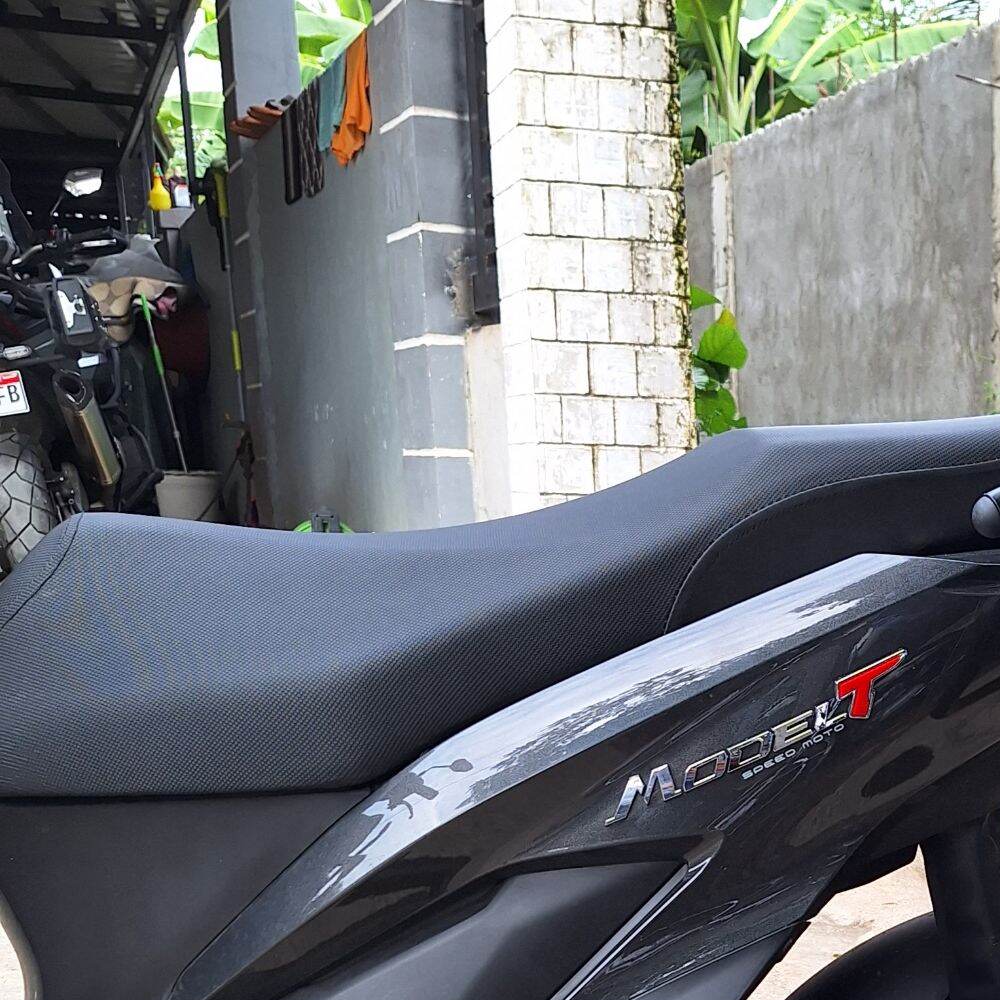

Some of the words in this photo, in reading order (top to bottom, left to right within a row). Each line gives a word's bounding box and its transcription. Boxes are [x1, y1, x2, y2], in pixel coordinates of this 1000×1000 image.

[834, 648, 908, 720] T
[741, 747, 797, 780] SPEED
[802, 723, 846, 750] MOTO
